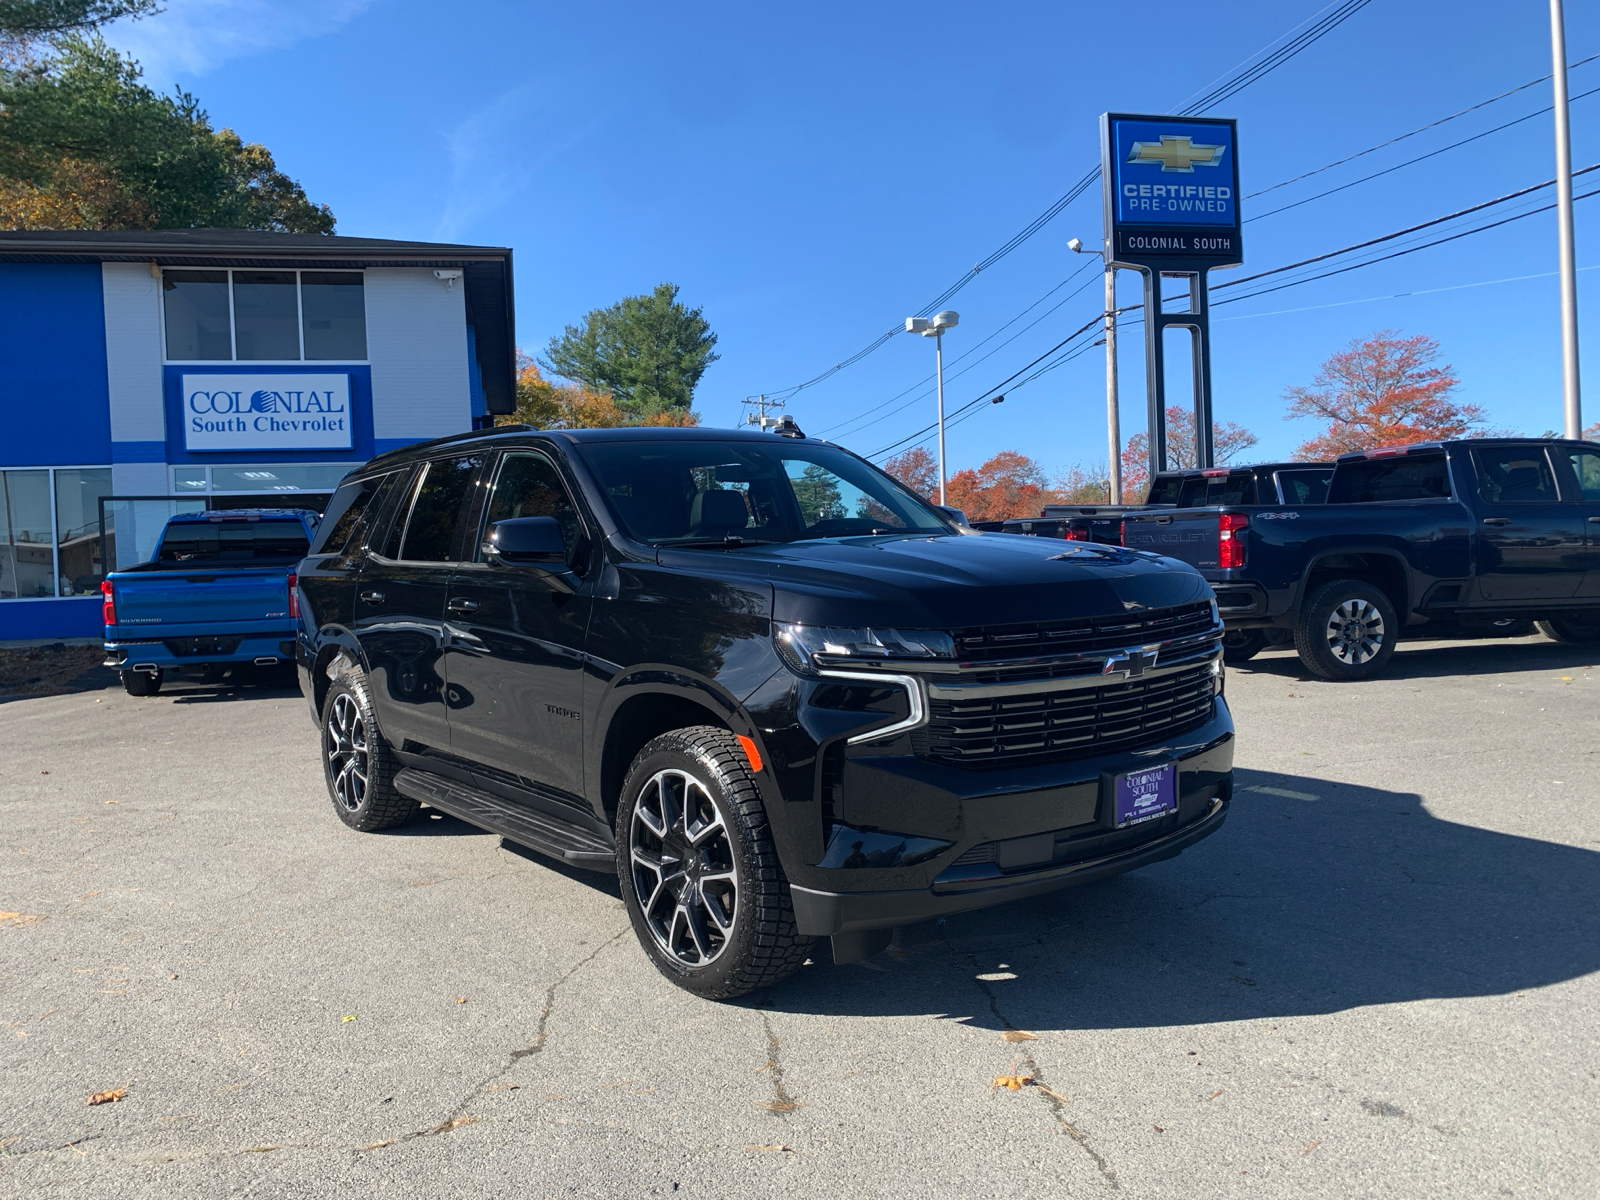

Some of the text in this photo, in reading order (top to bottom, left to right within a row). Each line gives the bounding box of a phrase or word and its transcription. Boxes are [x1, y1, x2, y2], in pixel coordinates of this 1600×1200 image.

[1123, 184, 1231, 199] CERTIFIED
[1129, 199, 1227, 212] PRE-OWNED
[1128, 236, 1231, 250] COLONIAL SOUTH
[189, 390, 345, 415] COLONIAL
[192, 416, 345, 433] South Chevrolet
[1127, 533, 1210, 544] CHEVROLET
[544, 703, 580, 720] TAHOE
[1126, 771, 1164, 788] COLONIAL
[1132, 781, 1159, 797] SOUTH
